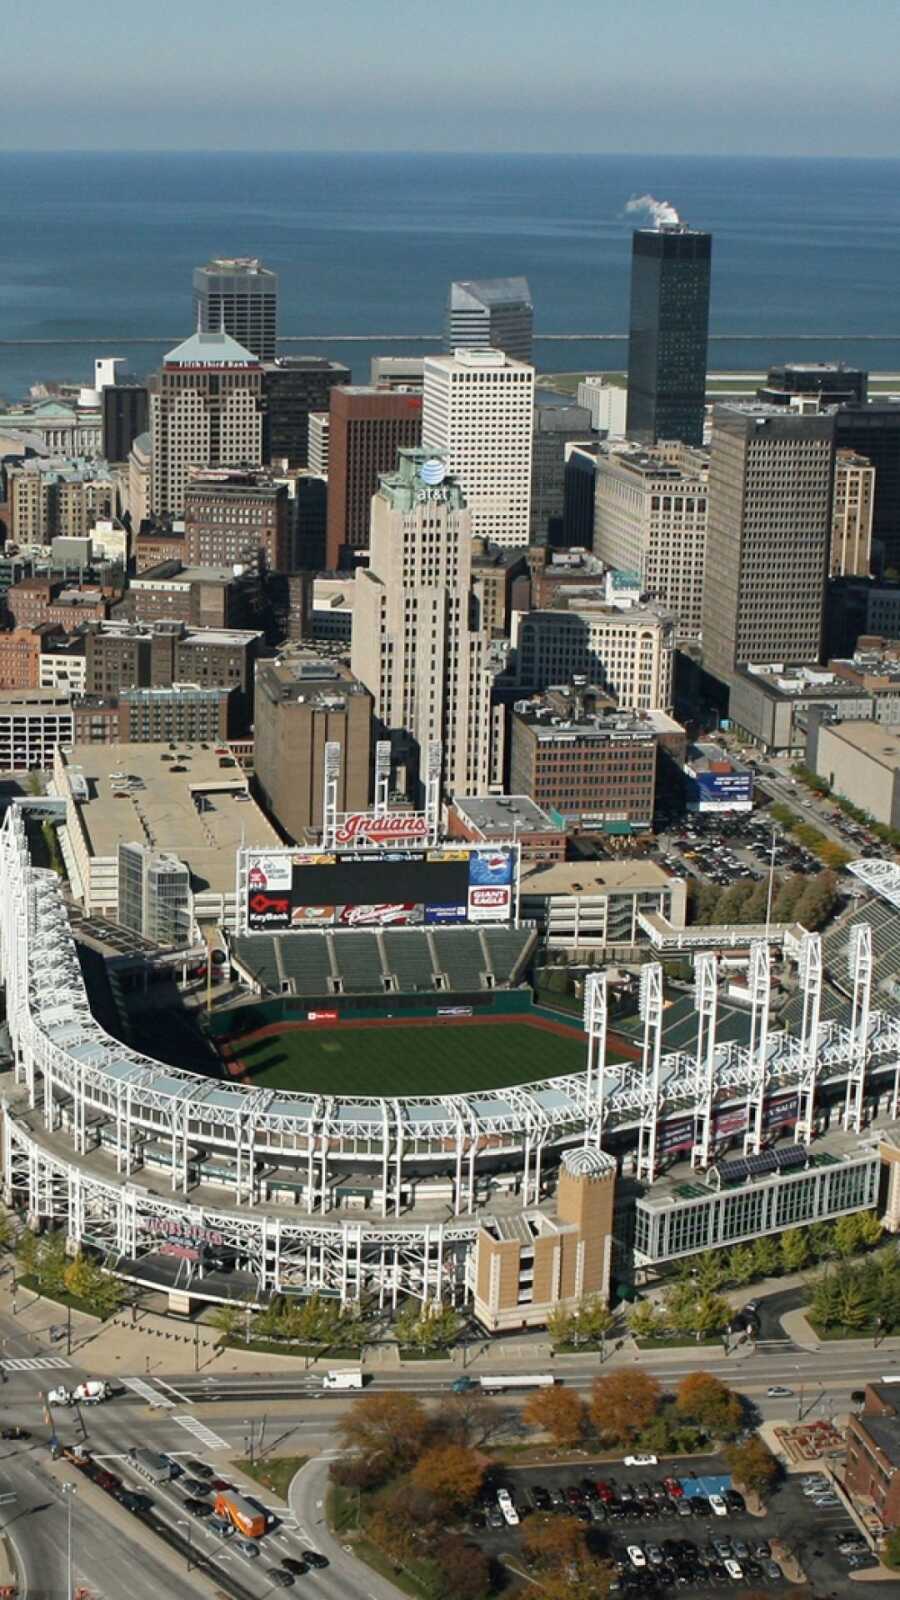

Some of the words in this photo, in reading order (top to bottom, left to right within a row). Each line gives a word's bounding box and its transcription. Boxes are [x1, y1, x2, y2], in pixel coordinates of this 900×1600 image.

[180, 359, 201, 369] Fifth
[202, 359, 225, 369] Third
[228, 359, 249, 369] Bank
[416, 486, 448, 501] at&t
[336, 815, 429, 843] Indians
[473, 890, 505, 898] GIANT
[473, 896, 505, 904] EAGLE
[250, 913, 288, 923] KeyBank
